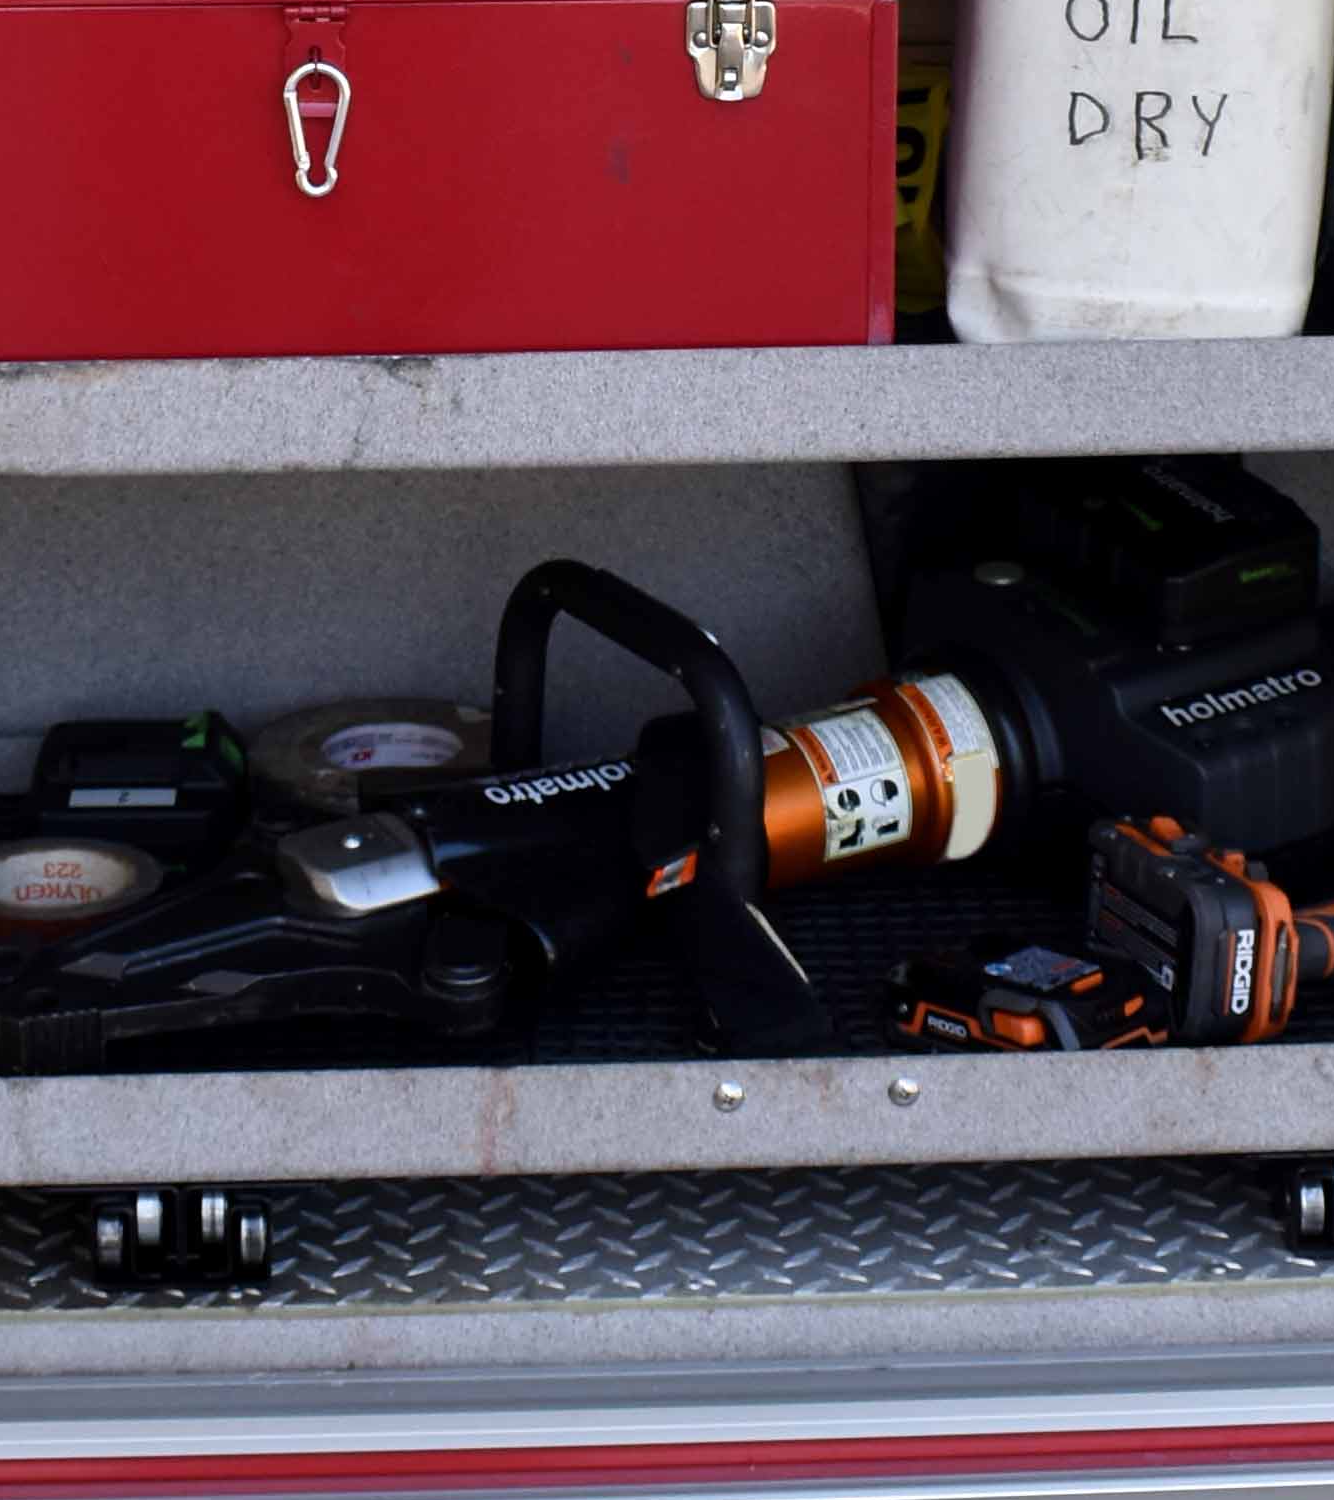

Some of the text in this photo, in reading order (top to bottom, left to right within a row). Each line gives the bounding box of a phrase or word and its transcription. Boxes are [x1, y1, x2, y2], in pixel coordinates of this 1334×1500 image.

[1068, 91, 1228, 161] DRY
[1160, 667, 1323, 728] holmatro
[43, 862, 84, 879] 223
[1230, 929, 1255, 1015] RIDGID
[926, 1014, 968, 1040] RIDGID
